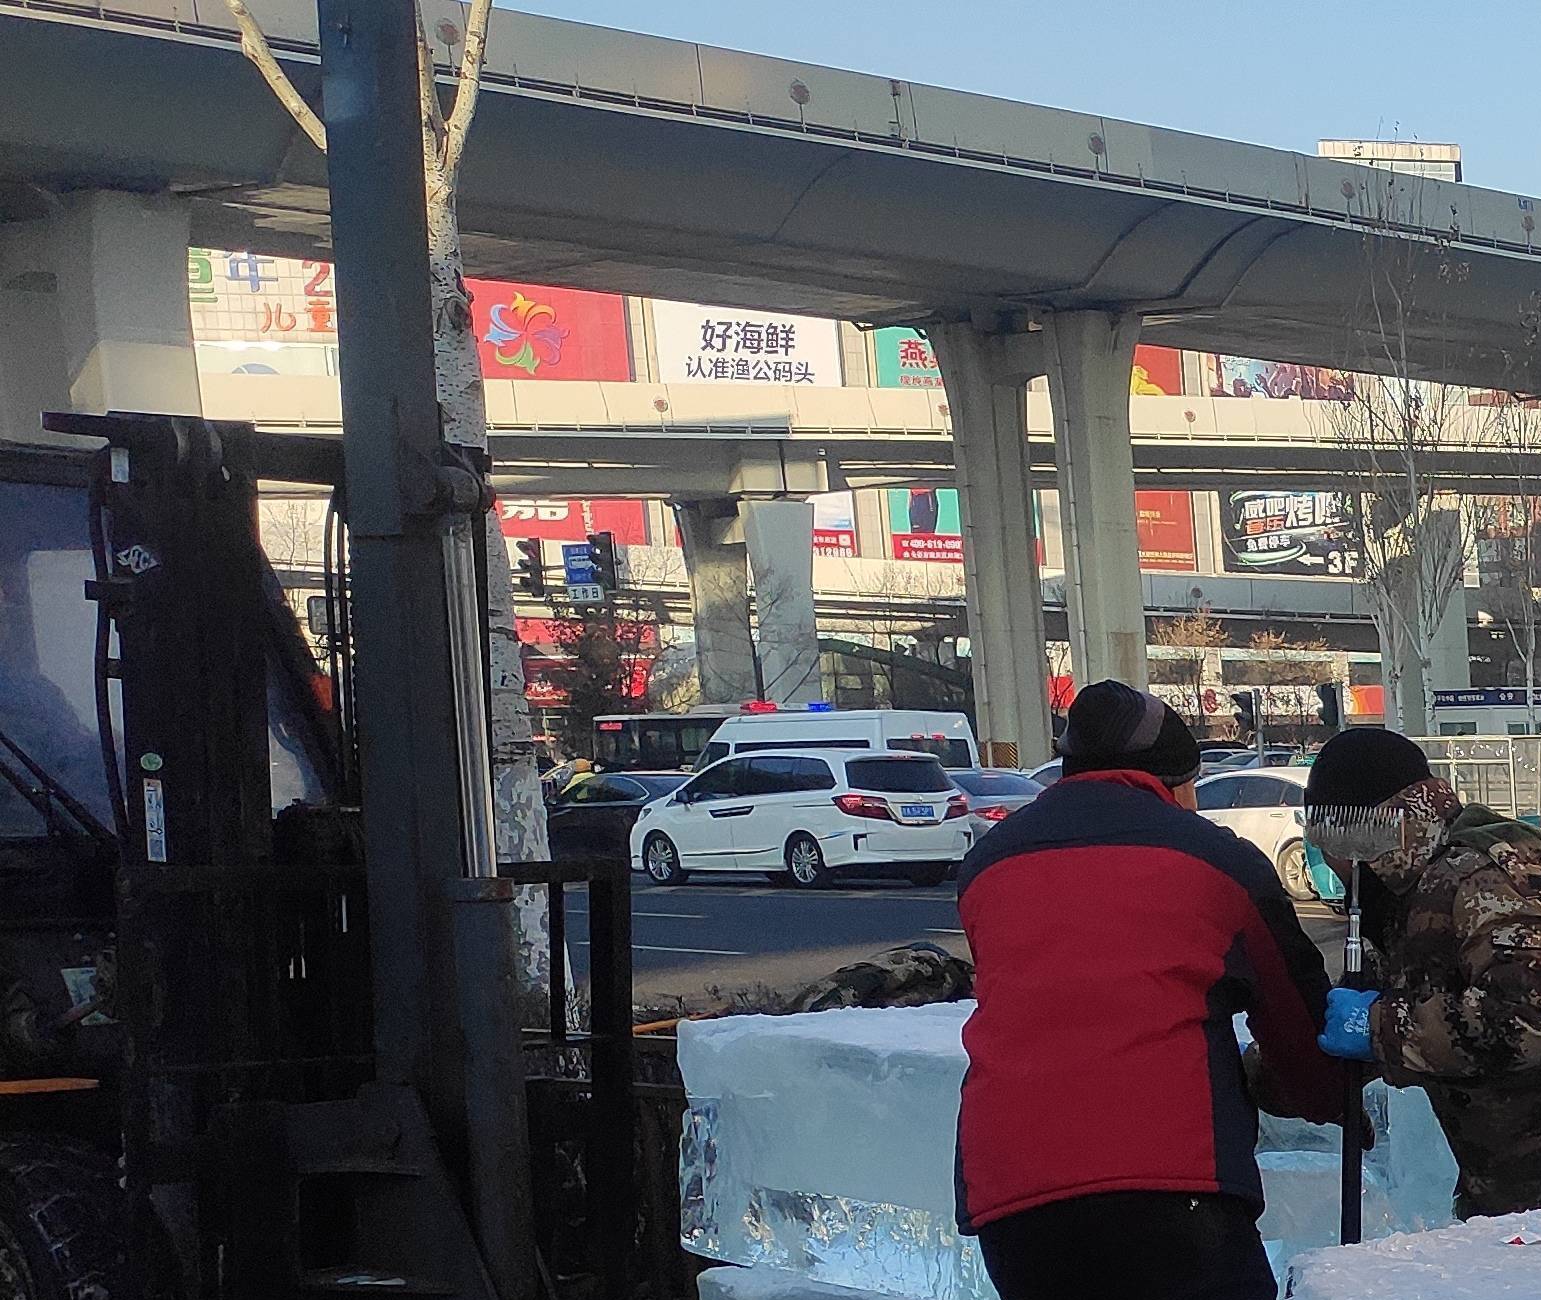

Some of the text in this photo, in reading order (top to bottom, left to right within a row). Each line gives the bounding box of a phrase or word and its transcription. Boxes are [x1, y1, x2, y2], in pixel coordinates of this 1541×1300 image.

[701, 319, 796, 356] 好海鲜
[686, 356, 816, 384] 认准渔公码头
[1327, 549, 1359, 574] 3F
